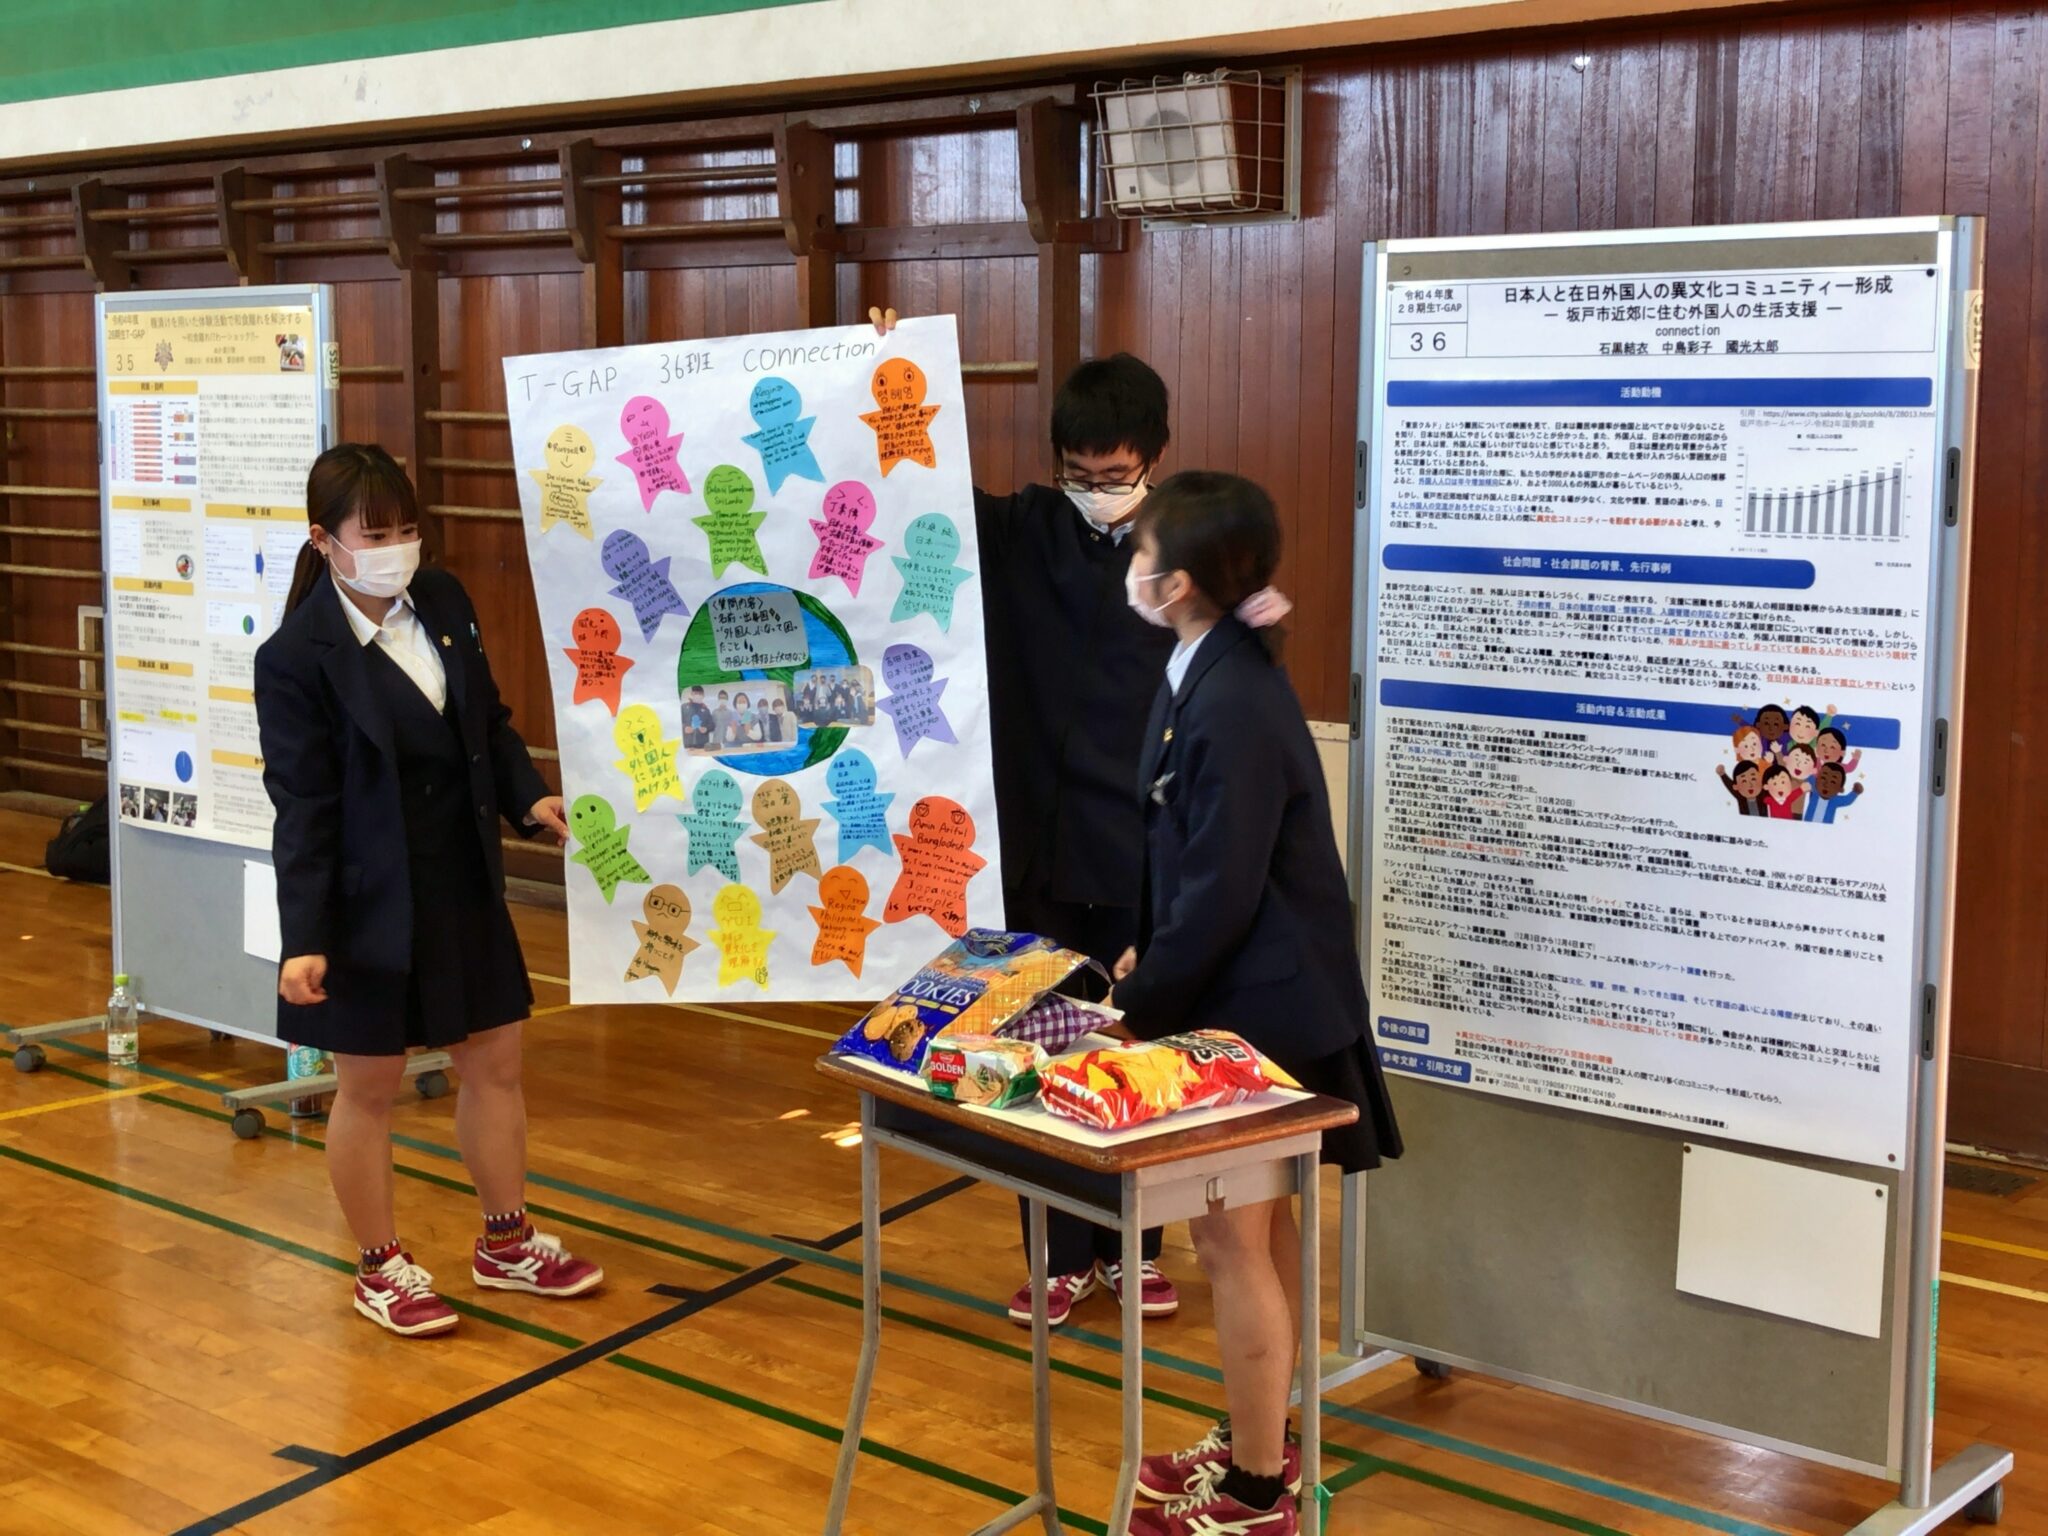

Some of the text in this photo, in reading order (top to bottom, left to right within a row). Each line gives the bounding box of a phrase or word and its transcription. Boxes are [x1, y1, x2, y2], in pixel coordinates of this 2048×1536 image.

[1404, 288, 1454, 300] 令和4年度
[1504, 275, 1893, 303] 日本人と在日外国人の異文化コミュニティー形成
[1567, 300, 1818, 322] 坂戸市近郊に住む外国人の生活支援
[1655, 324, 1720, 337] connection
[1410, 331, 1446, 351] 36
[1599, 342, 1649, 355] 石黒結衣
[1662, 340, 1713, 355] 中島彩子
[116, 353, 135, 372] 35
[659, 353, 714, 384] 36班
[519, 366, 618, 402] T-GAP
[1619, 386, 1662, 400] 活動動機
[1503, 556, 1672, 574] 社会問題・社会課題の背景、先行事例
[913, 818, 935, 830] Amin
[917, 833, 965, 851] Bangladesh
[905, 879, 966, 900] Japanese
[889, 901, 965, 924] is very shy
[897, 979, 979, 1007] OOKIES
[1381, 1021, 1427, 1040] 今後の展望
[930, 1062, 965, 1075] GOLDEN
[1381, 1050, 1463, 1077] 参考文献・引用文献
